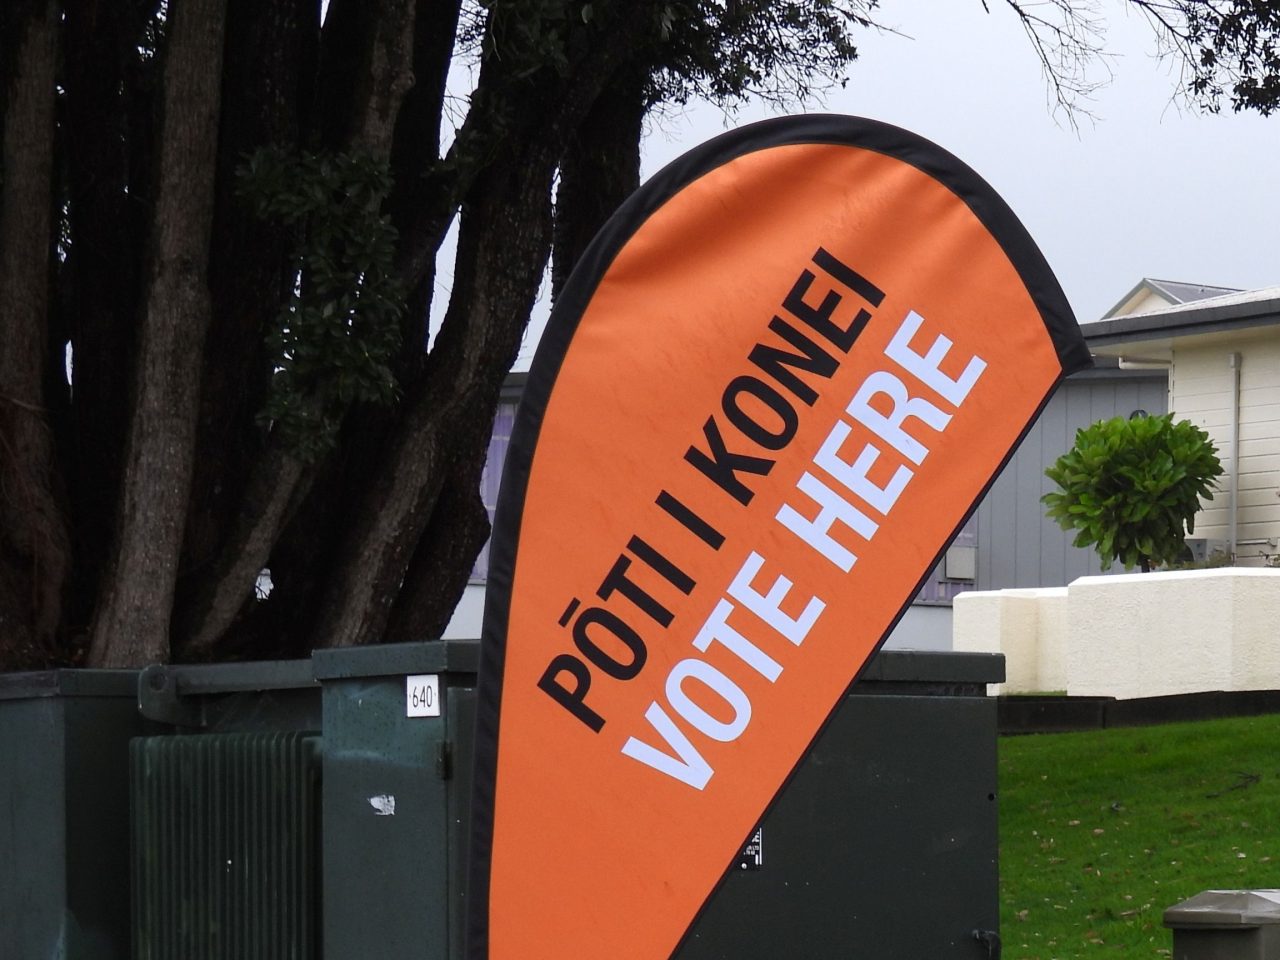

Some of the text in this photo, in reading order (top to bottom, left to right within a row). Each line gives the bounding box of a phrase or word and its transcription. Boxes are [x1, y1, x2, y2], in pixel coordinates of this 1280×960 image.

[412, 685, 433, 708] 640
[537, 246, 887, 735] PŌTI I KONEI
[620, 309, 988, 791] VOTE HERE
